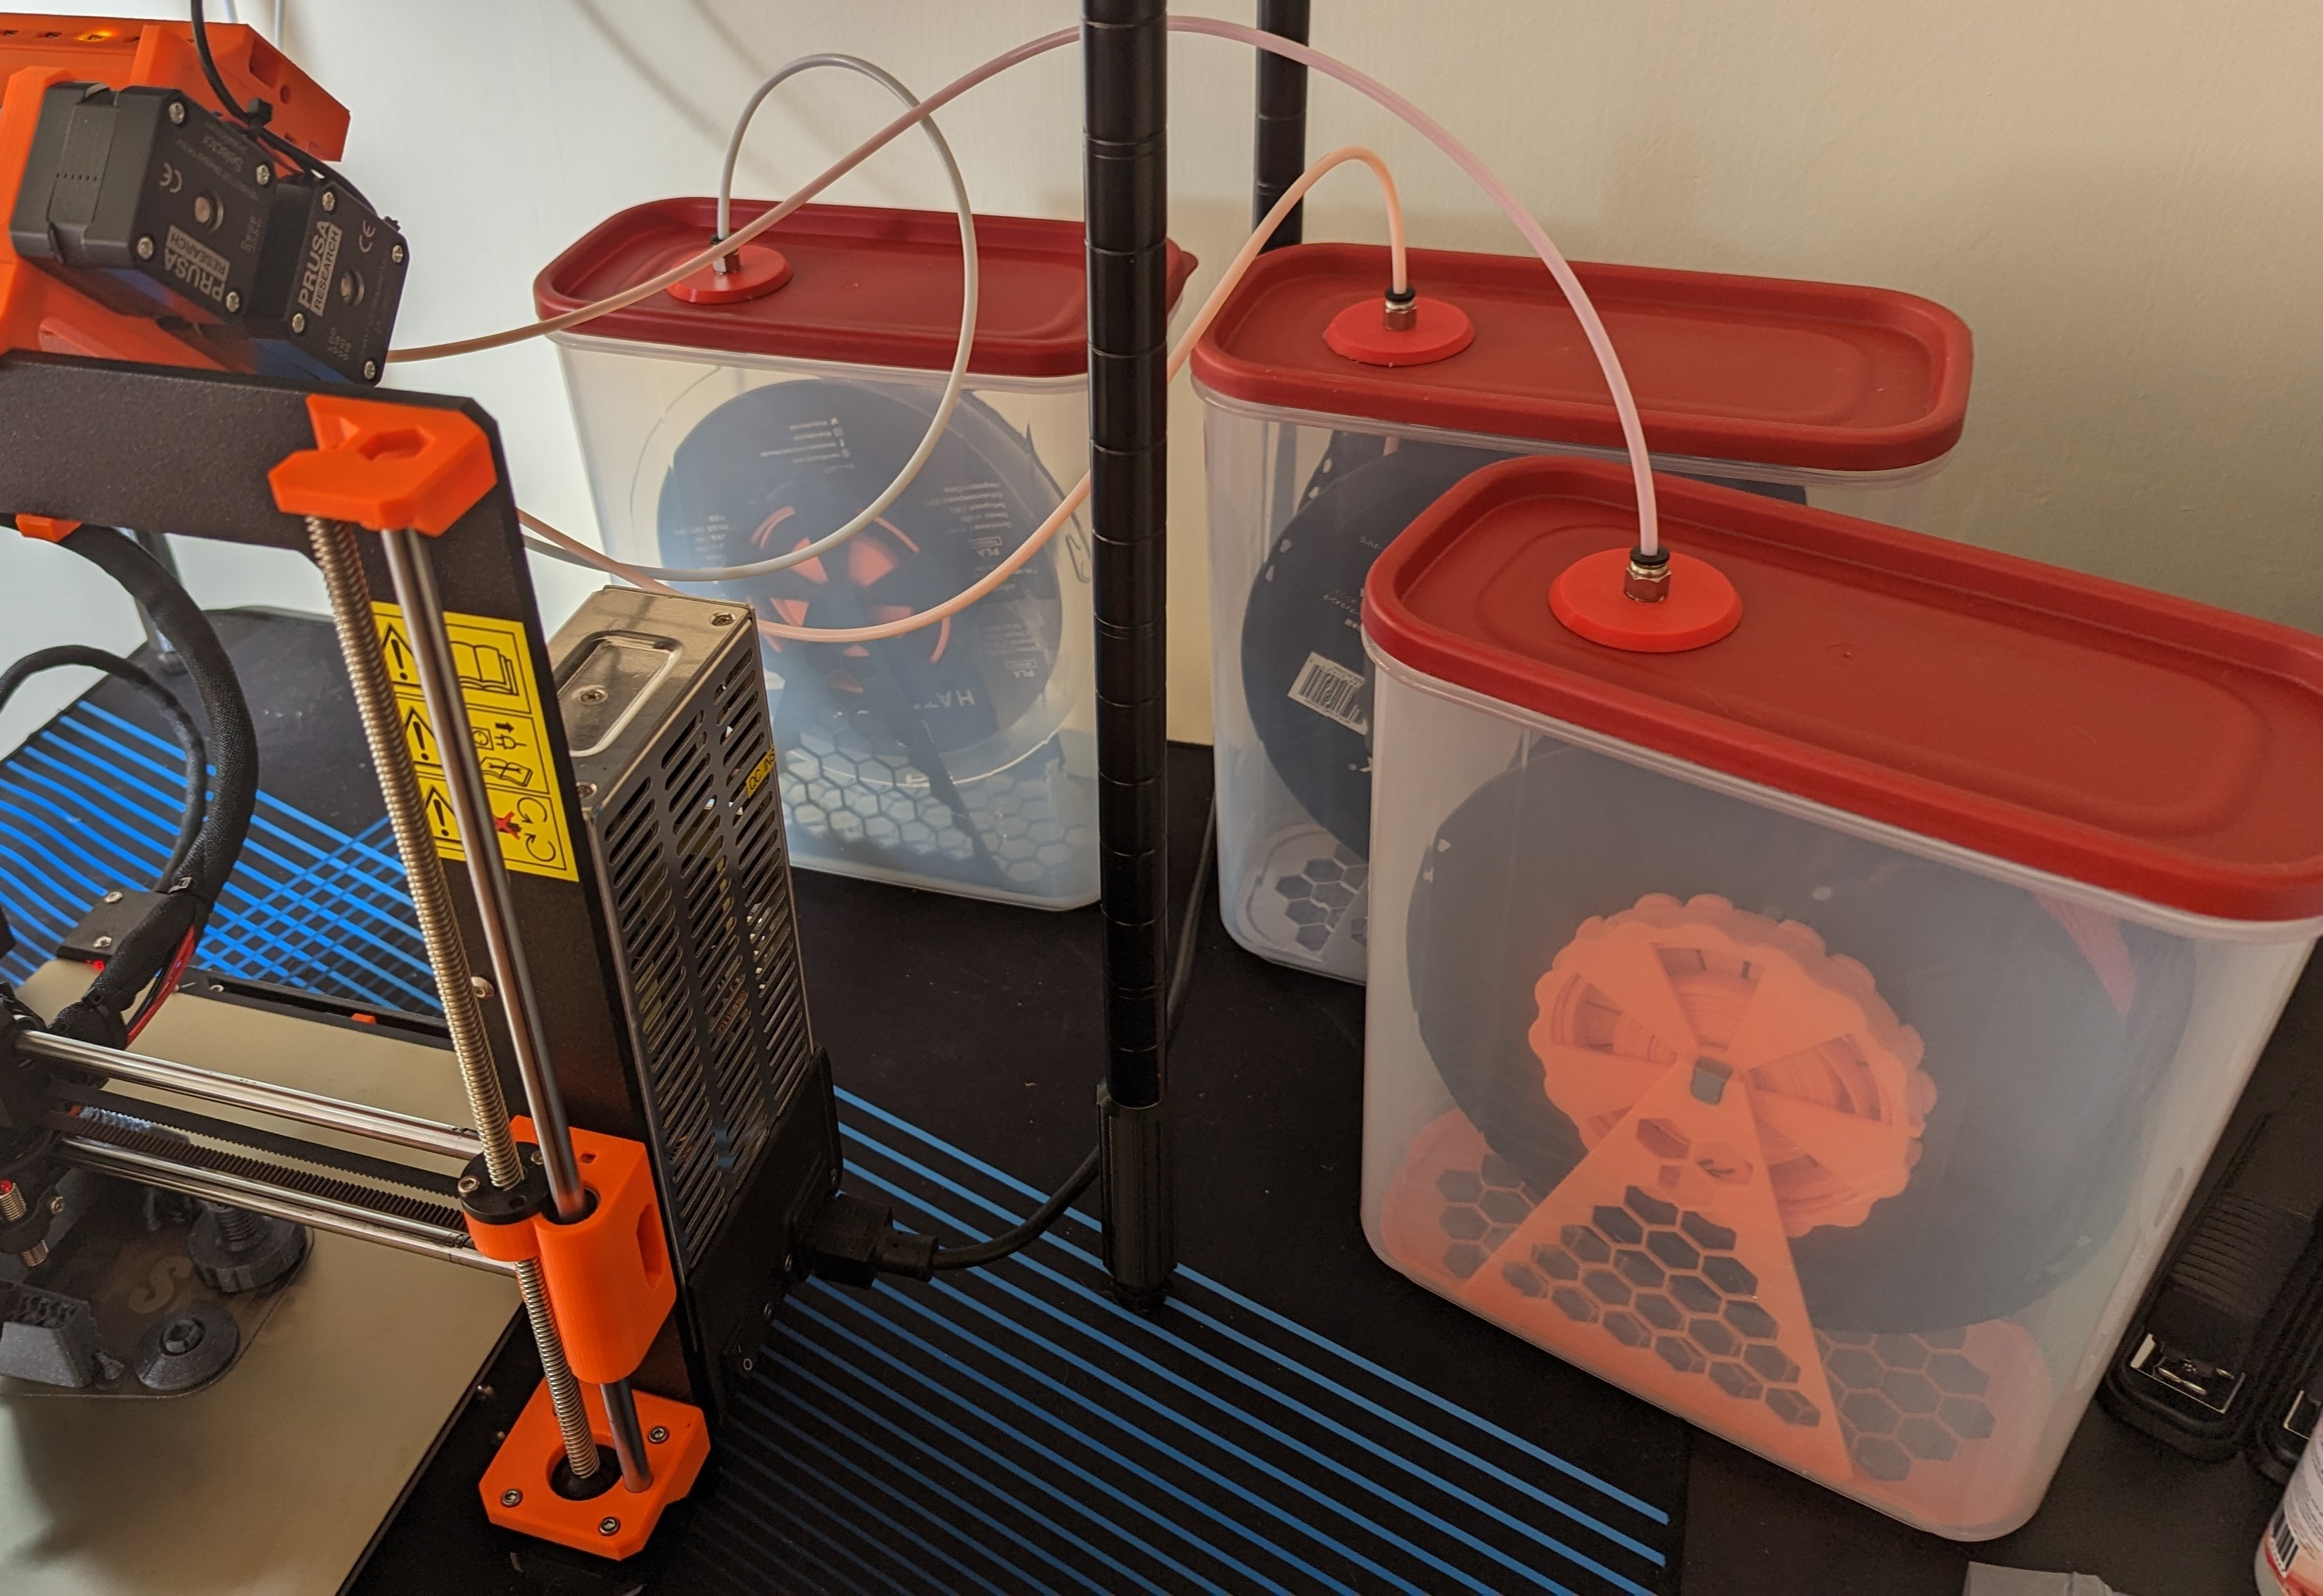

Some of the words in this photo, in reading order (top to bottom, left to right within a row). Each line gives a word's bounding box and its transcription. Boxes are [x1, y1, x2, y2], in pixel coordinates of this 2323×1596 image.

[164, 247, 225, 303] PRUSA
[170, 232, 226, 275] RESEARCH
[298, 221, 331, 309] PRUSA
[315, 229, 340, 310] RESEARCH
[977, 547, 1001, 557] PLA
[749, 768, 761, 790] QC
